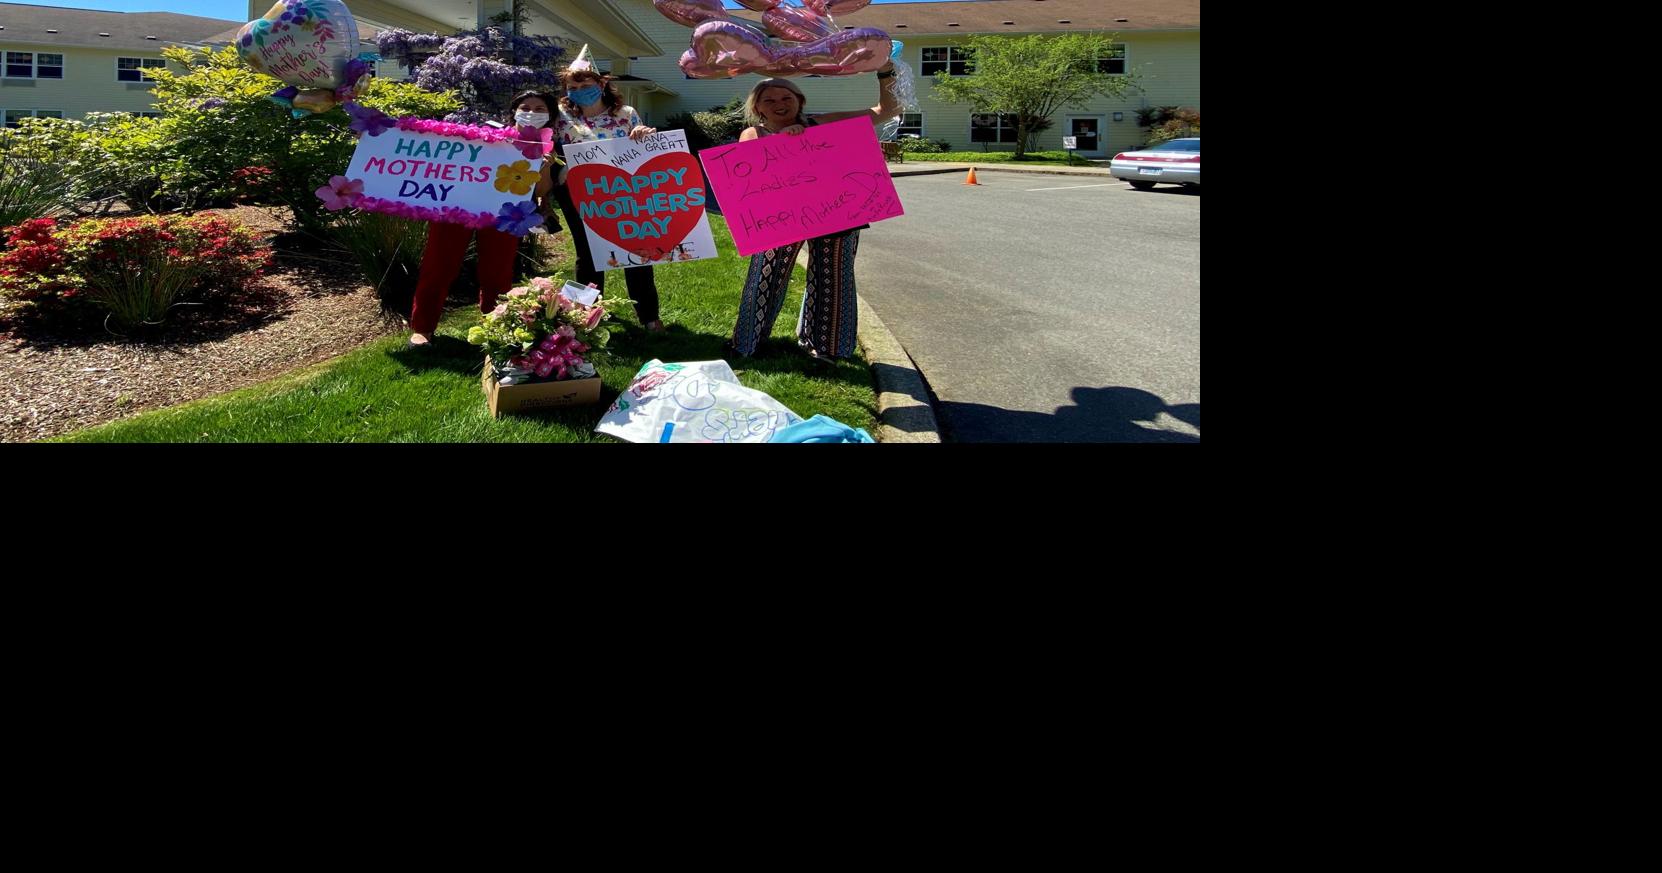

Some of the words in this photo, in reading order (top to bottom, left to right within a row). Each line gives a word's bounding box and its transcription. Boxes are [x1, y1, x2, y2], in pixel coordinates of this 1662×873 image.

[259, 34, 296, 60] Happy
[268, 41, 326, 81] Mother's
[299, 60, 331, 84] Day!
[395, 138, 483, 162] HAPPY
[572, 145, 608, 164] MOM
[610, 148, 641, 167] NANA
[645, 139, 686, 152] GREAT
[364, 156, 492, 183] MOTHERS
[709, 146, 752, 178] To
[398, 179, 454, 202] DAY
[583, 167, 688, 196] HAPPY
[579, 189, 706, 219] MOTHERS
[617, 216, 673, 240] DAY
